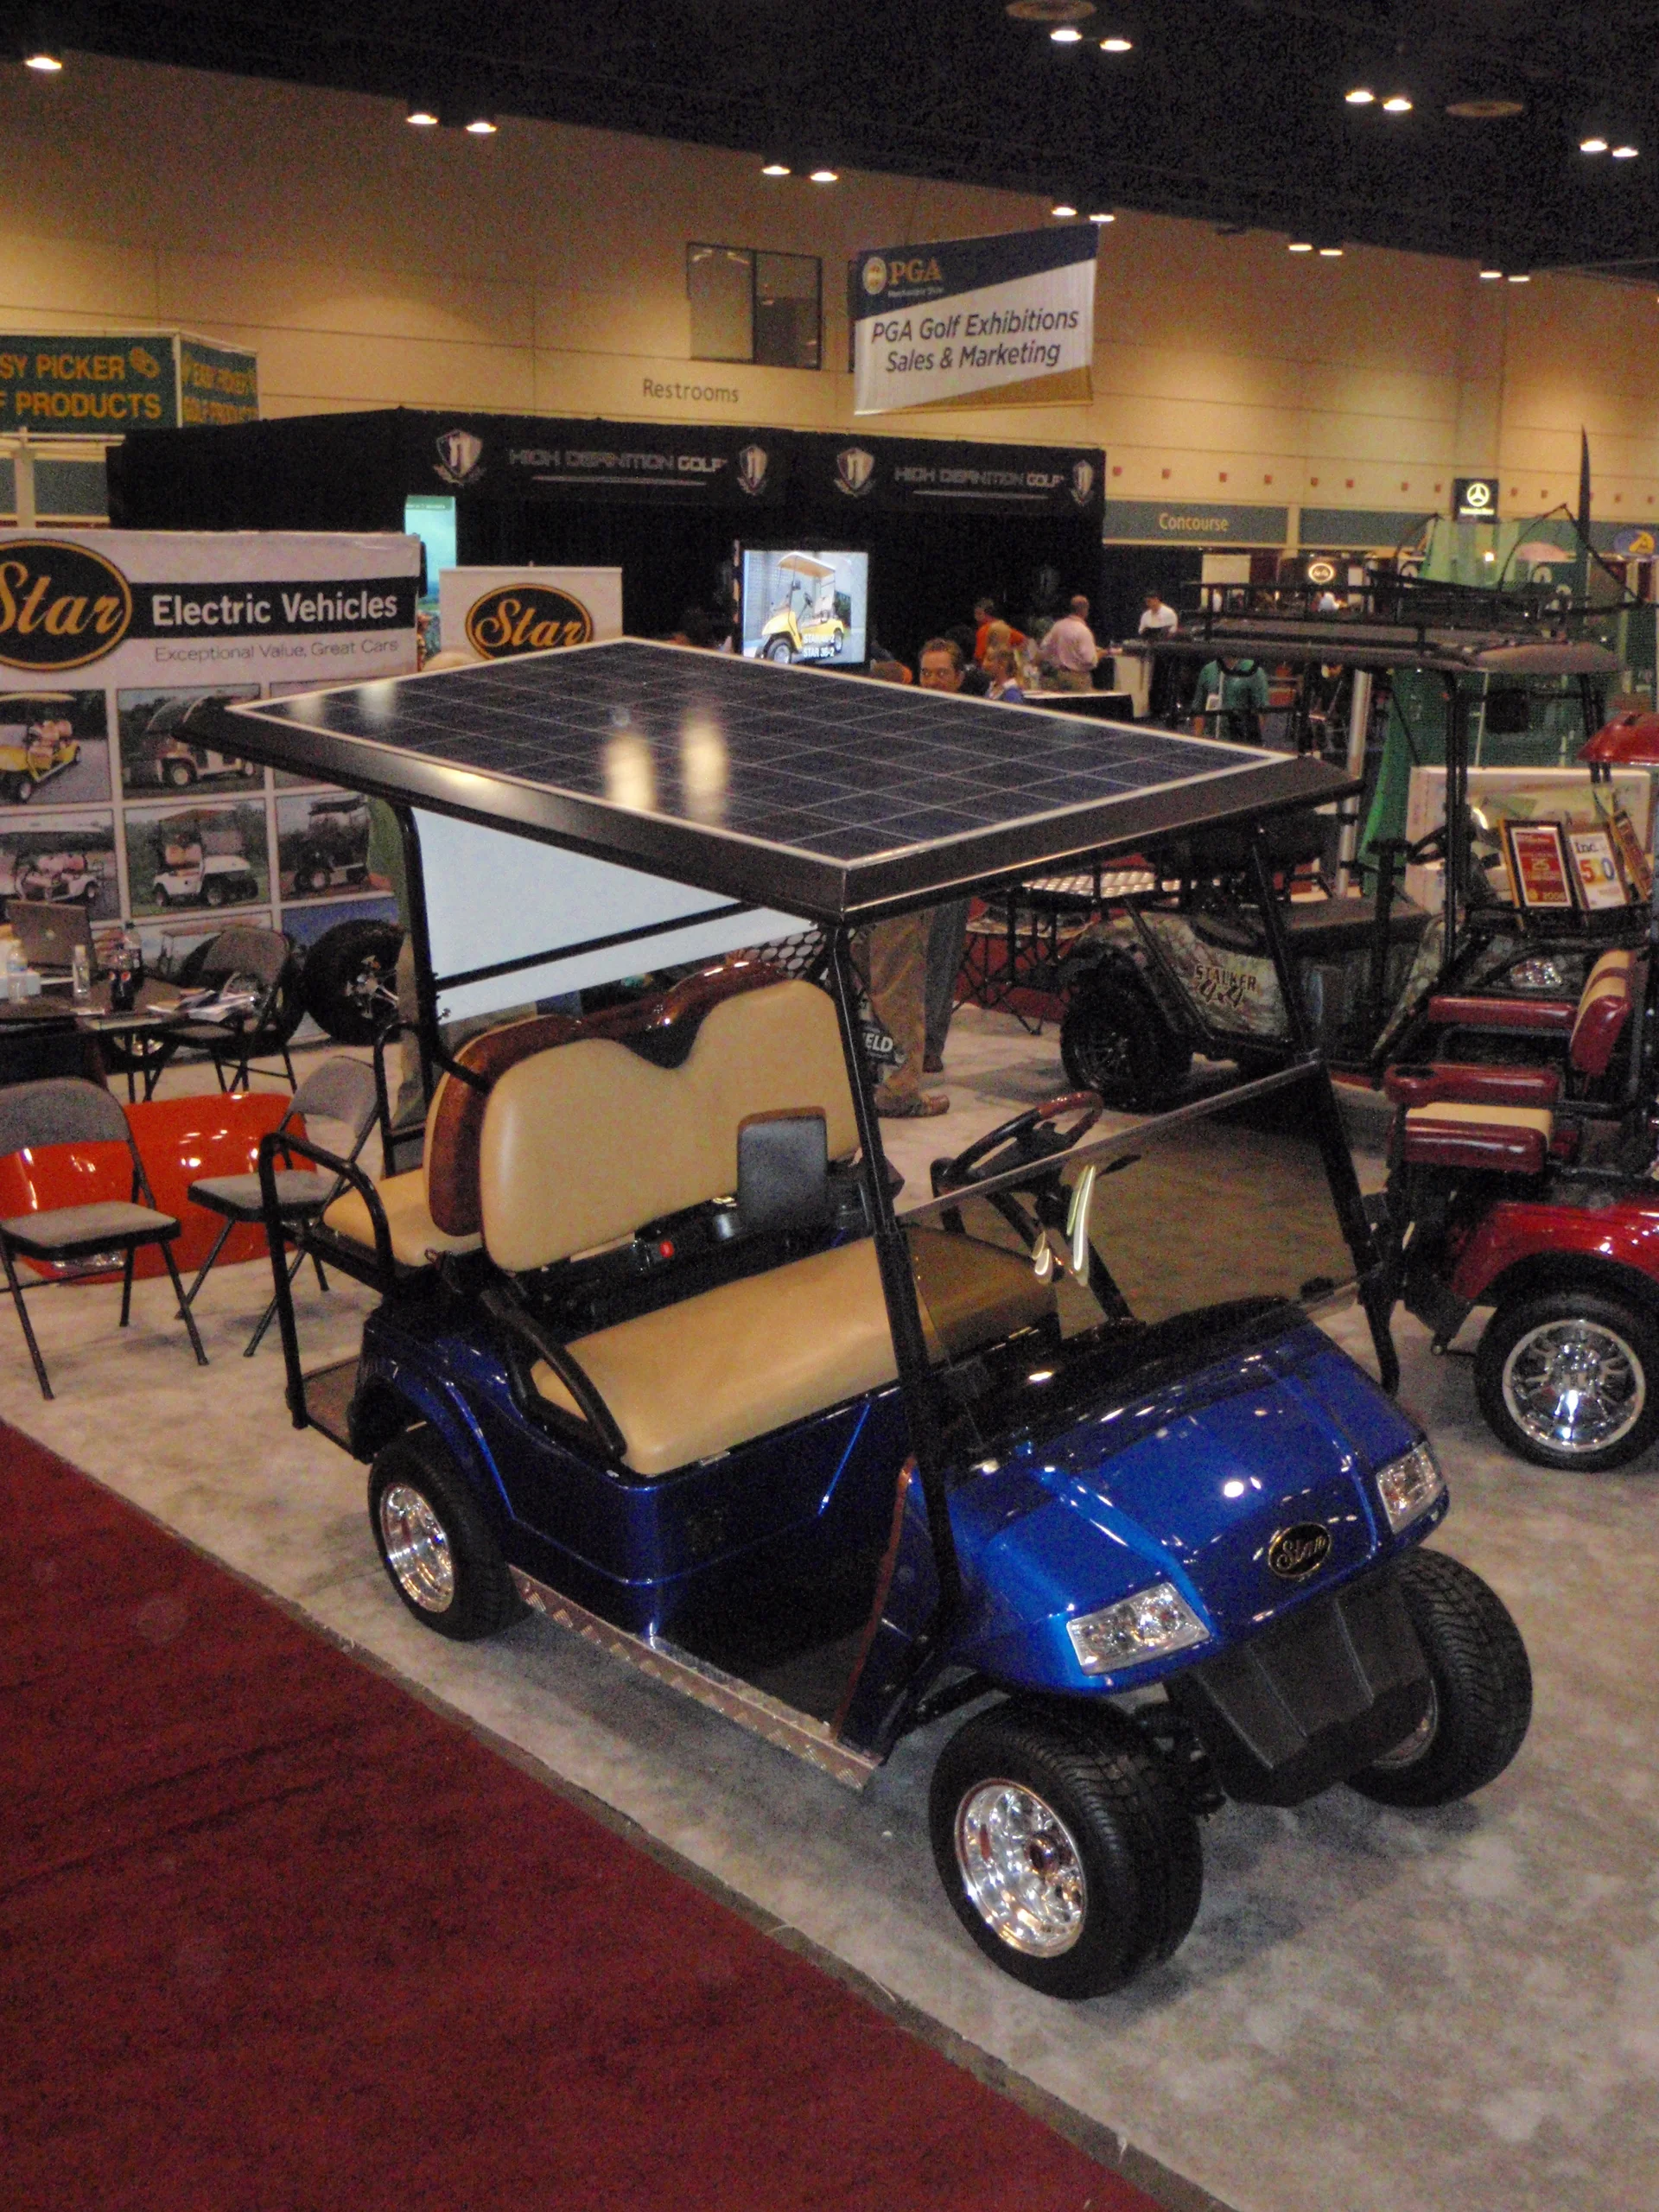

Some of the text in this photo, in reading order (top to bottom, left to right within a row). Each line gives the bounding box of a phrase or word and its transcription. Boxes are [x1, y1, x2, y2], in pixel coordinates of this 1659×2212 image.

[888, 258, 943, 285] PGA
[871, 307, 1079, 343] PGA Golf Exhibitions
[35, 354, 125, 381] PICKER
[886, 340, 1061, 373] Sales & Marketing
[642, 378, 739, 403] Restrooms
[16, 391, 162, 419] PRODUCTS
[677, 454, 726, 473] GOLF
[1159, 512, 1230, 531] Concourse
[151, 592, 271, 626] Electric
[281, 590, 398, 624] Vehicles
[476, 598, 584, 647] Star
[155, 638, 399, 663] Exceptional Value, Great Cars
[803, 646, 820, 658] STAR
[1196, 964, 1257, 992] STALKER
